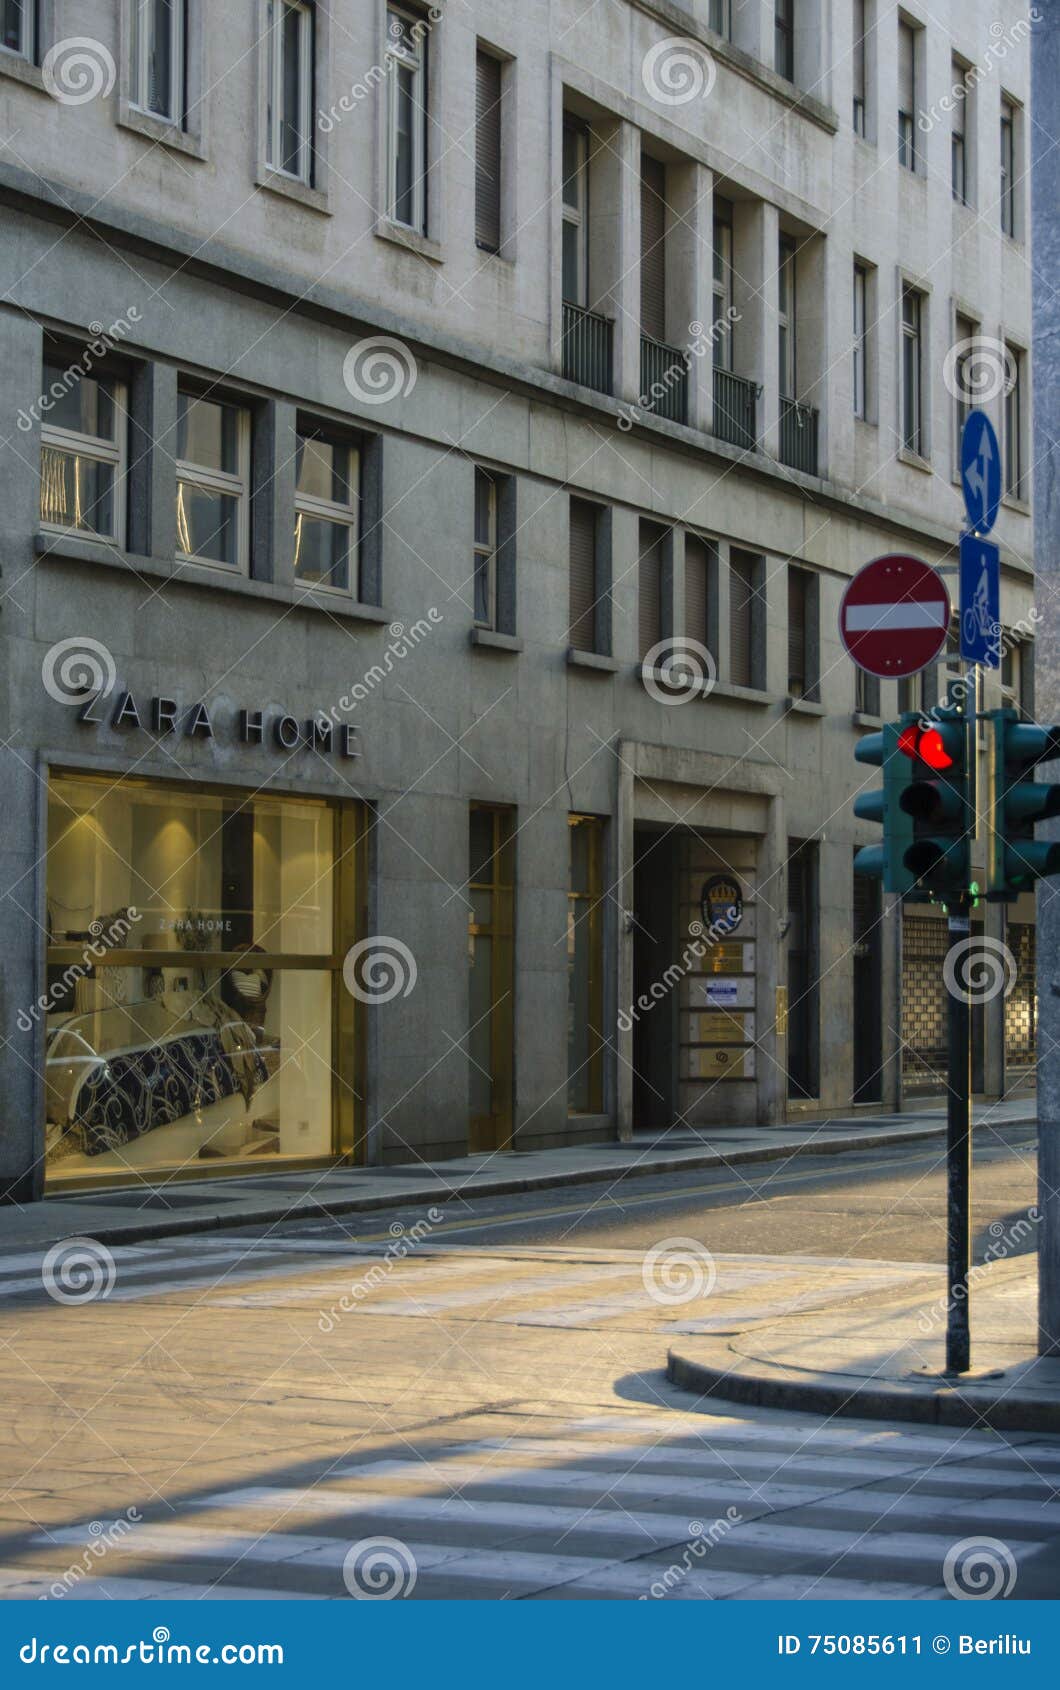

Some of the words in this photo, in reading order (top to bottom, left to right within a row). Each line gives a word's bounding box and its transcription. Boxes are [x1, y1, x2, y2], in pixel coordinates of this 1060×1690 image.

[79, 686, 216, 738] ZARA
[240, 708, 362, 759] HOME
[159, 919, 193, 931] ZARA
[197, 920, 233, 932] HOME
